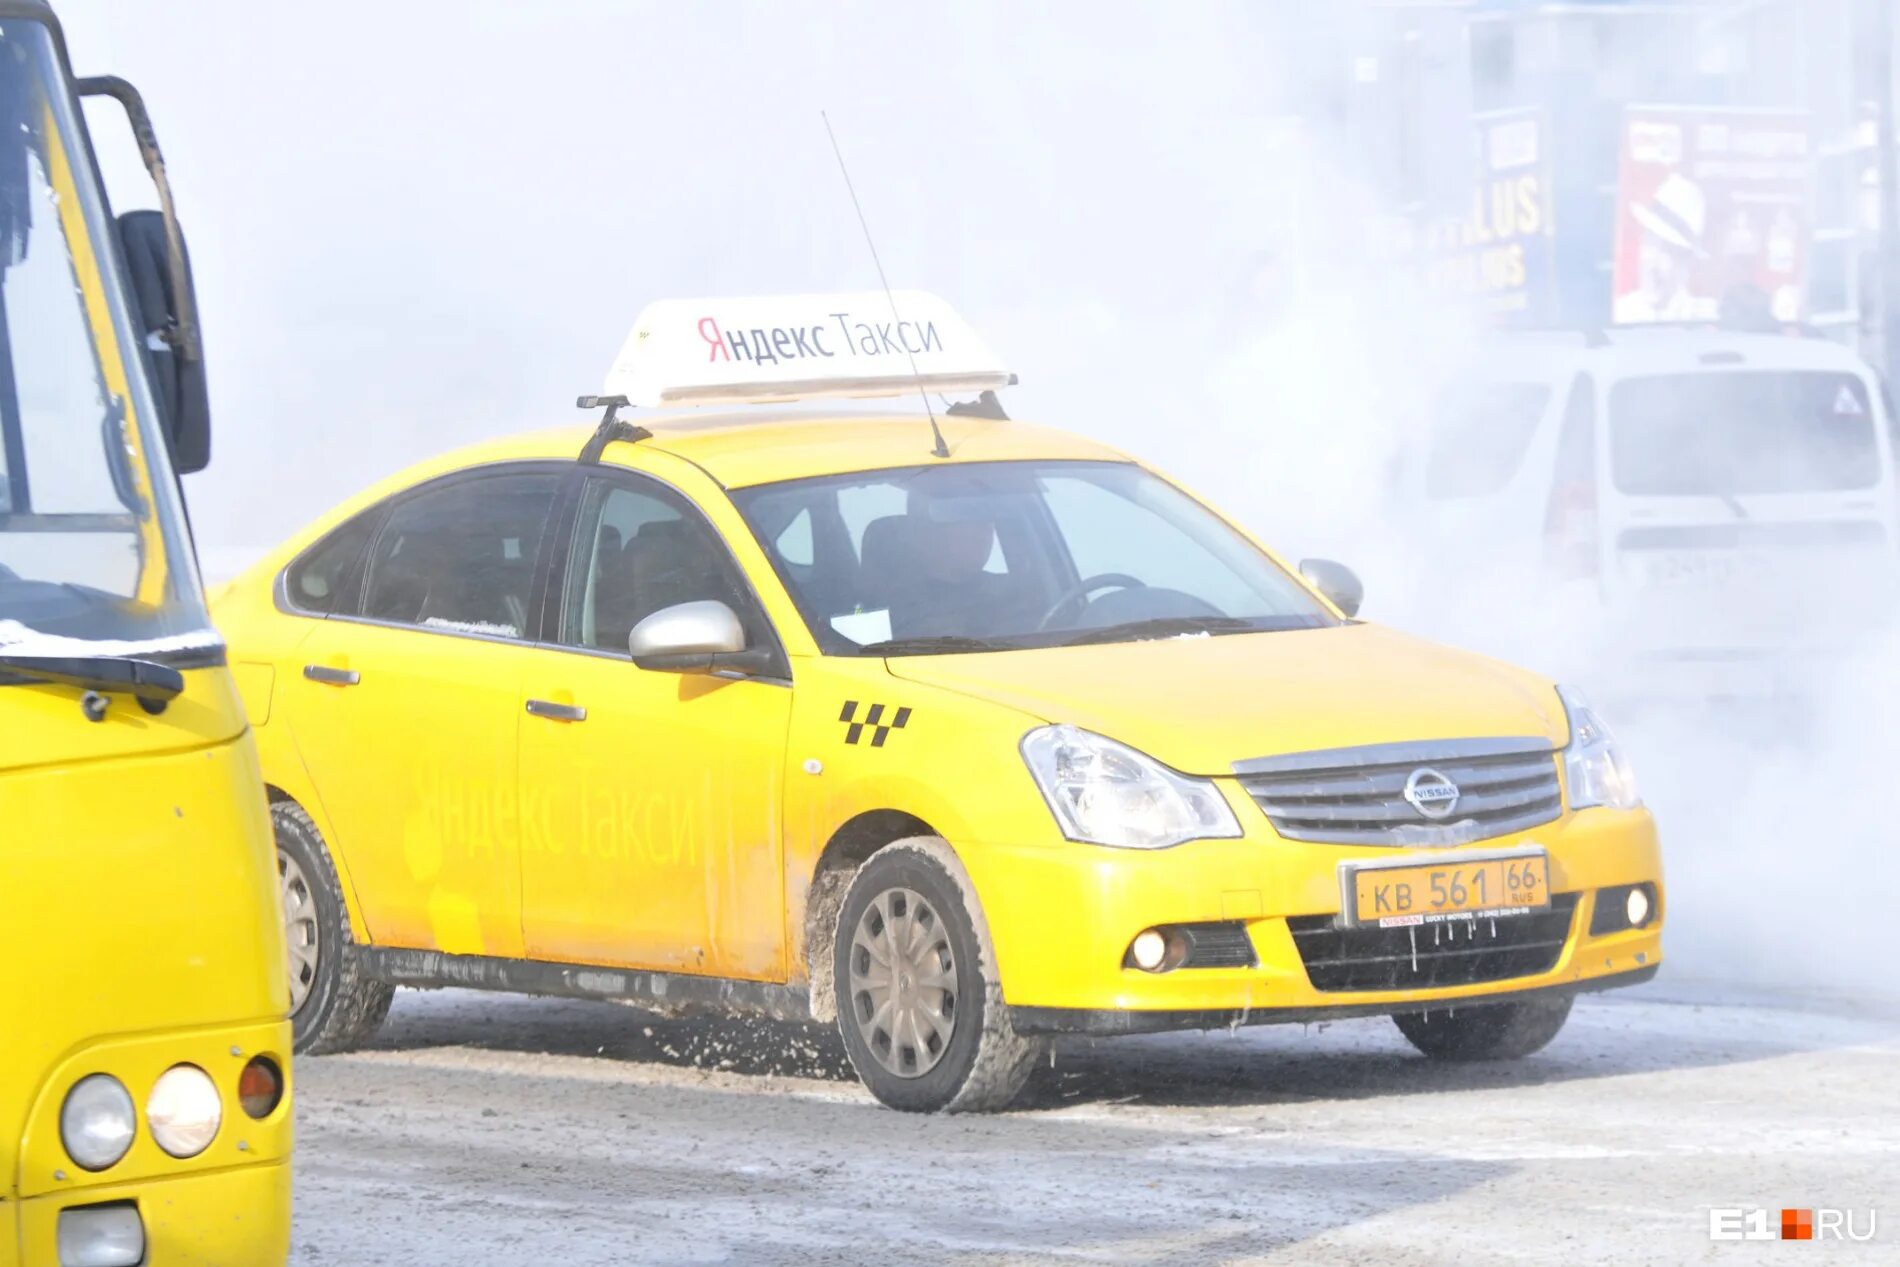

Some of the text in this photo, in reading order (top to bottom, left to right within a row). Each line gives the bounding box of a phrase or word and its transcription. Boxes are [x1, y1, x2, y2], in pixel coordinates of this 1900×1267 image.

[697, 313, 943, 366] Яндекс Такси
[1413, 787, 1456, 799] NISSAN
[571, 760, 696, 867] Такси
[1430, 868, 1488, 908] 561
[1507, 862, 1536, 890] 66
[1511, 892, 1534, 904] RUS
[1381, 915, 1422, 927] NISSAN
